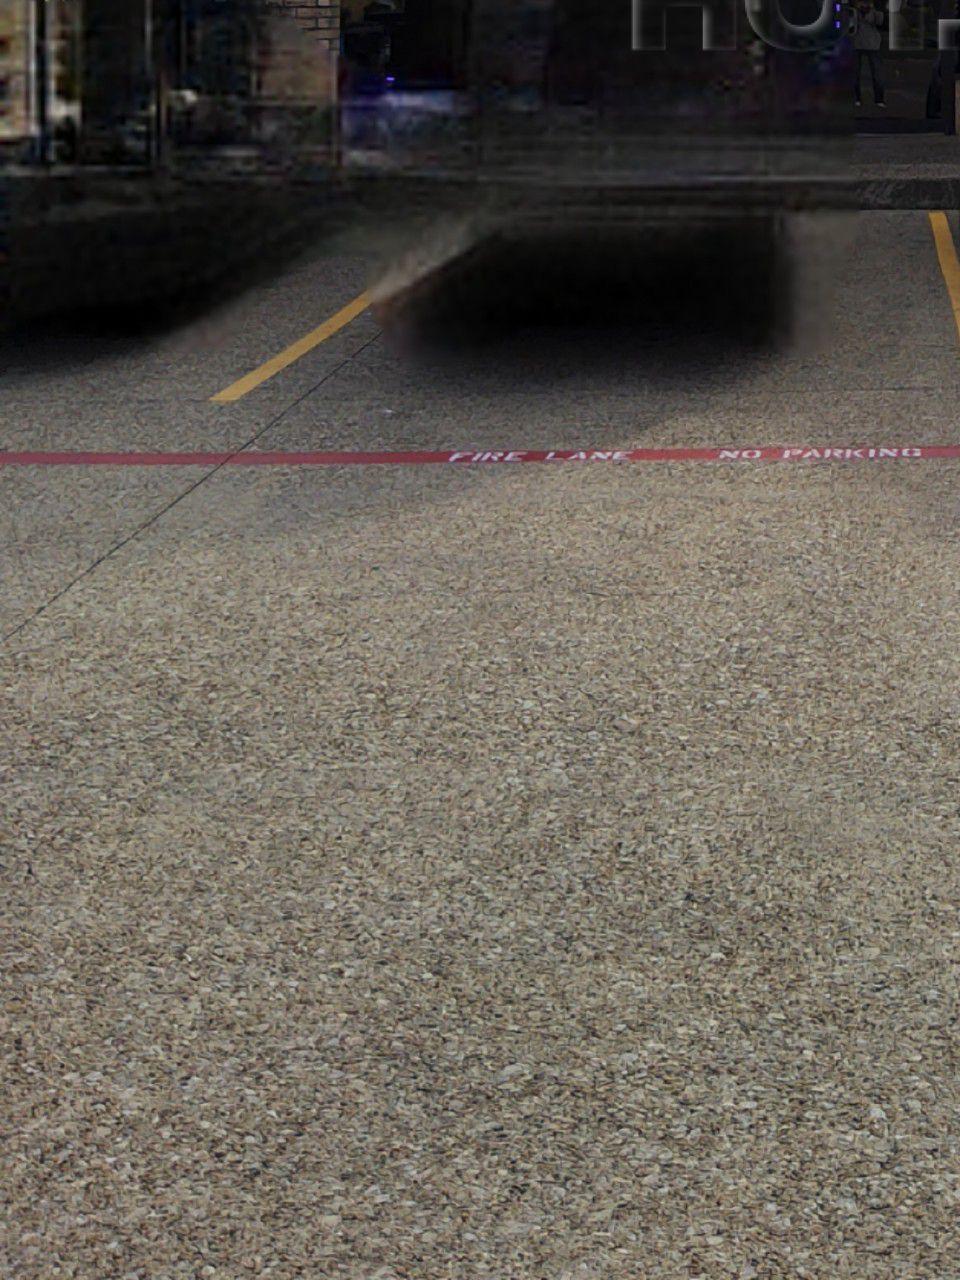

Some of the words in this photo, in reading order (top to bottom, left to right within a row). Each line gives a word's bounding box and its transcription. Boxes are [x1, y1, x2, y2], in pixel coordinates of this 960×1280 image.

[448, 451, 528, 463] FIRE
[545, 451, 634, 462] LANE
[719, 449, 762, 460] NO
[783, 448, 921, 459] PARKING
